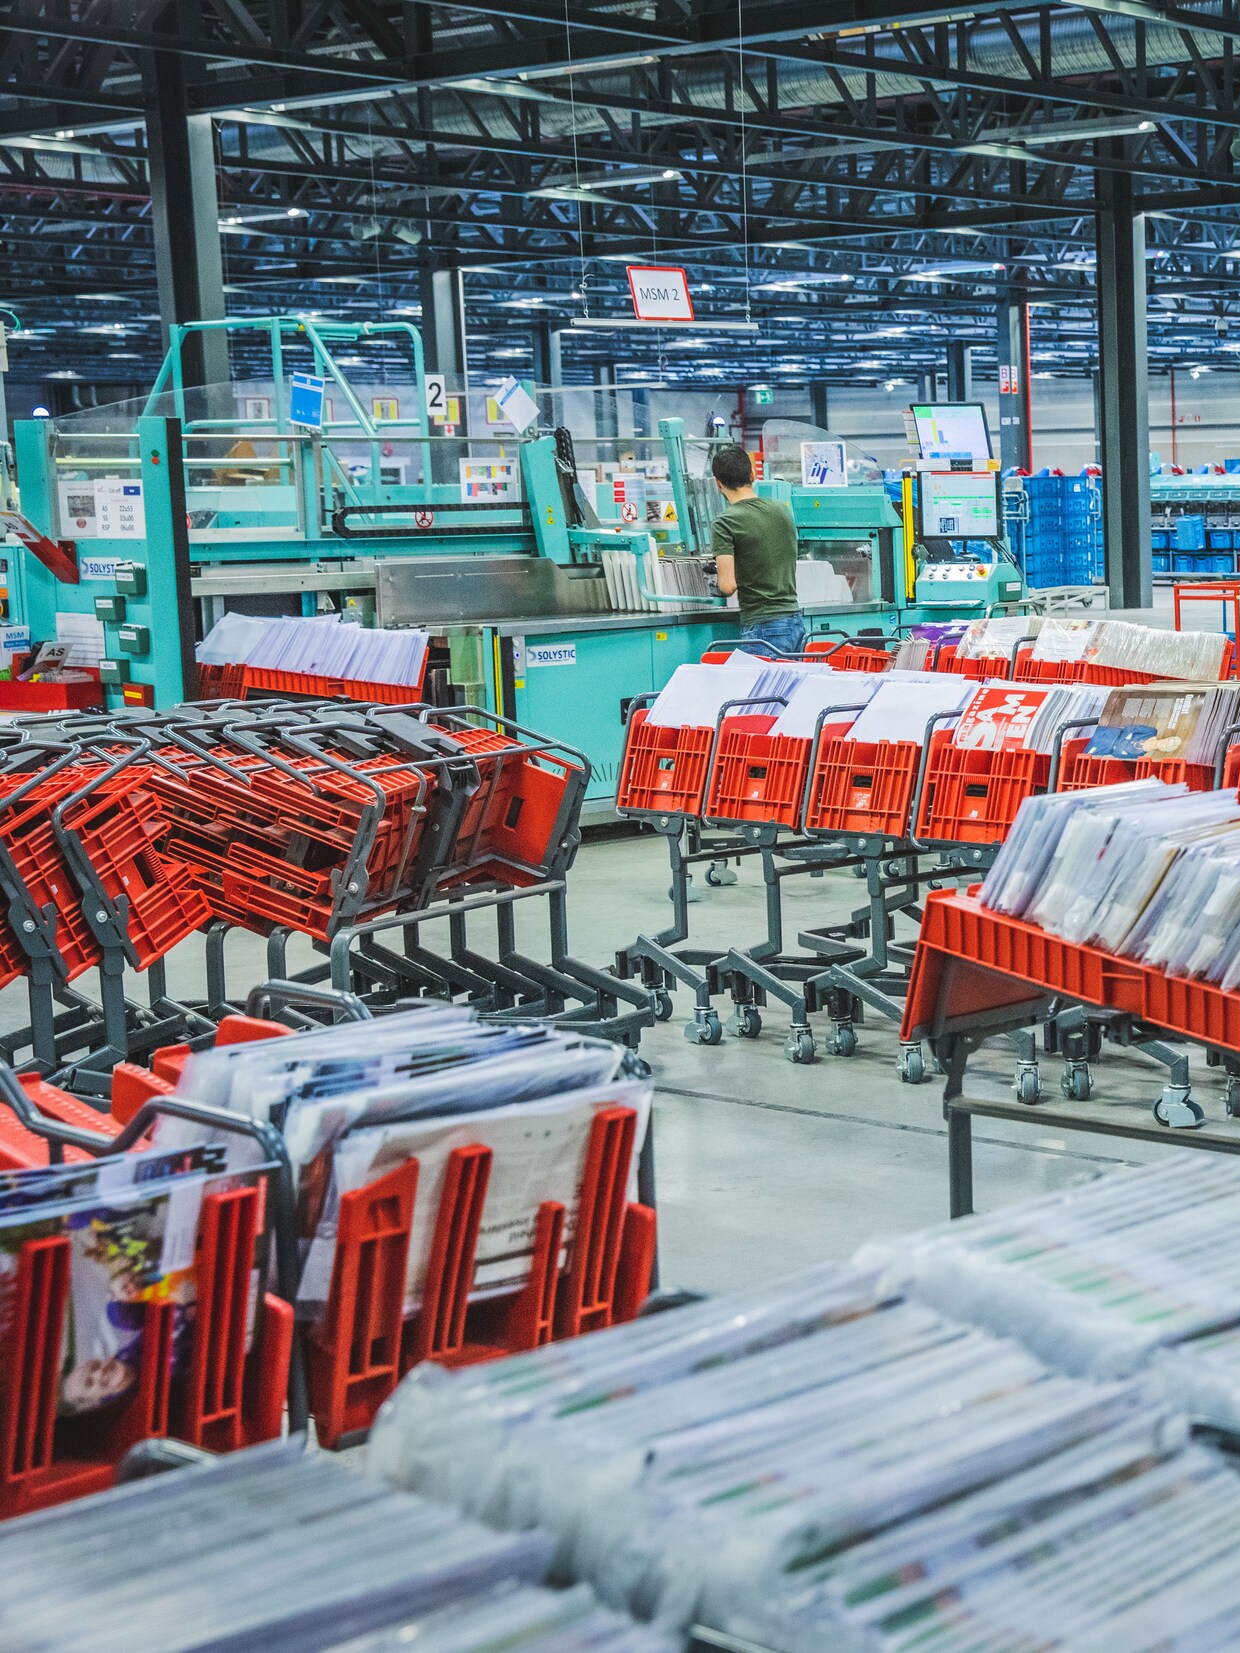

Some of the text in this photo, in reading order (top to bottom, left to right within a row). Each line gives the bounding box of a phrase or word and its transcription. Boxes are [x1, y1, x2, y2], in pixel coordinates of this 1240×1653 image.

[639, 288, 680, 301] MSM 2
[428, 382, 443, 407] 2
[90, 563, 115, 573] SOLYST
[46, 647, 65, 657] AS
[538, 649, 576, 660] SOLYSTIC
[960, 688, 990, 742] magazine
